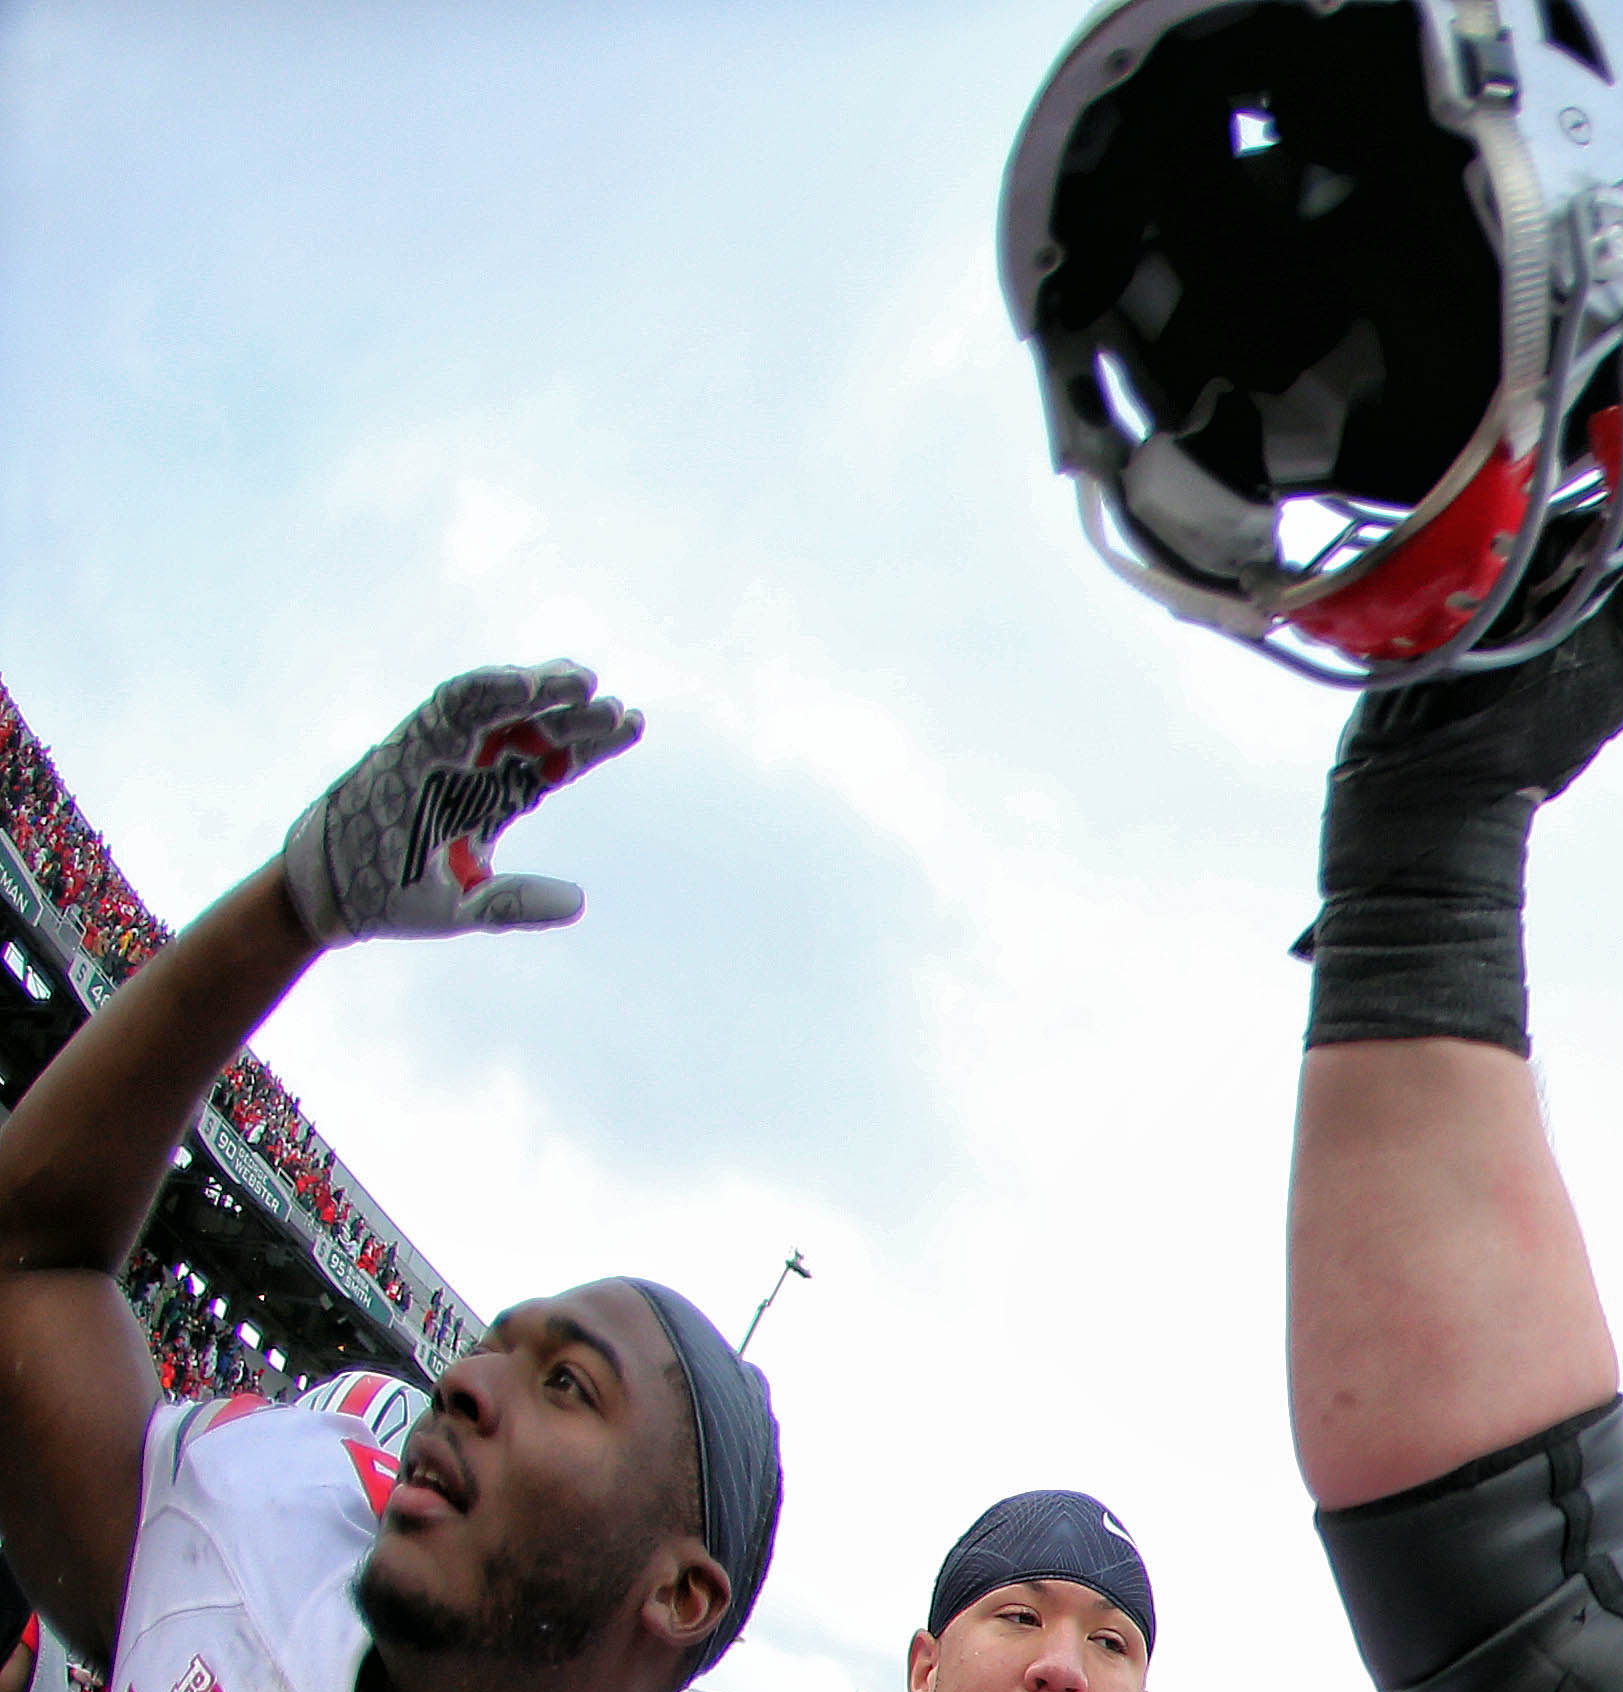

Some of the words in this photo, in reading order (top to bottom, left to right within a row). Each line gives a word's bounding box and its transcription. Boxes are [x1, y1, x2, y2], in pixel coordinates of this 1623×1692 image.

[234, 1158, 280, 1214] WEBSTER
[330, 1254, 346, 1277] 95
[345, 1276, 372, 1308] SMITH
